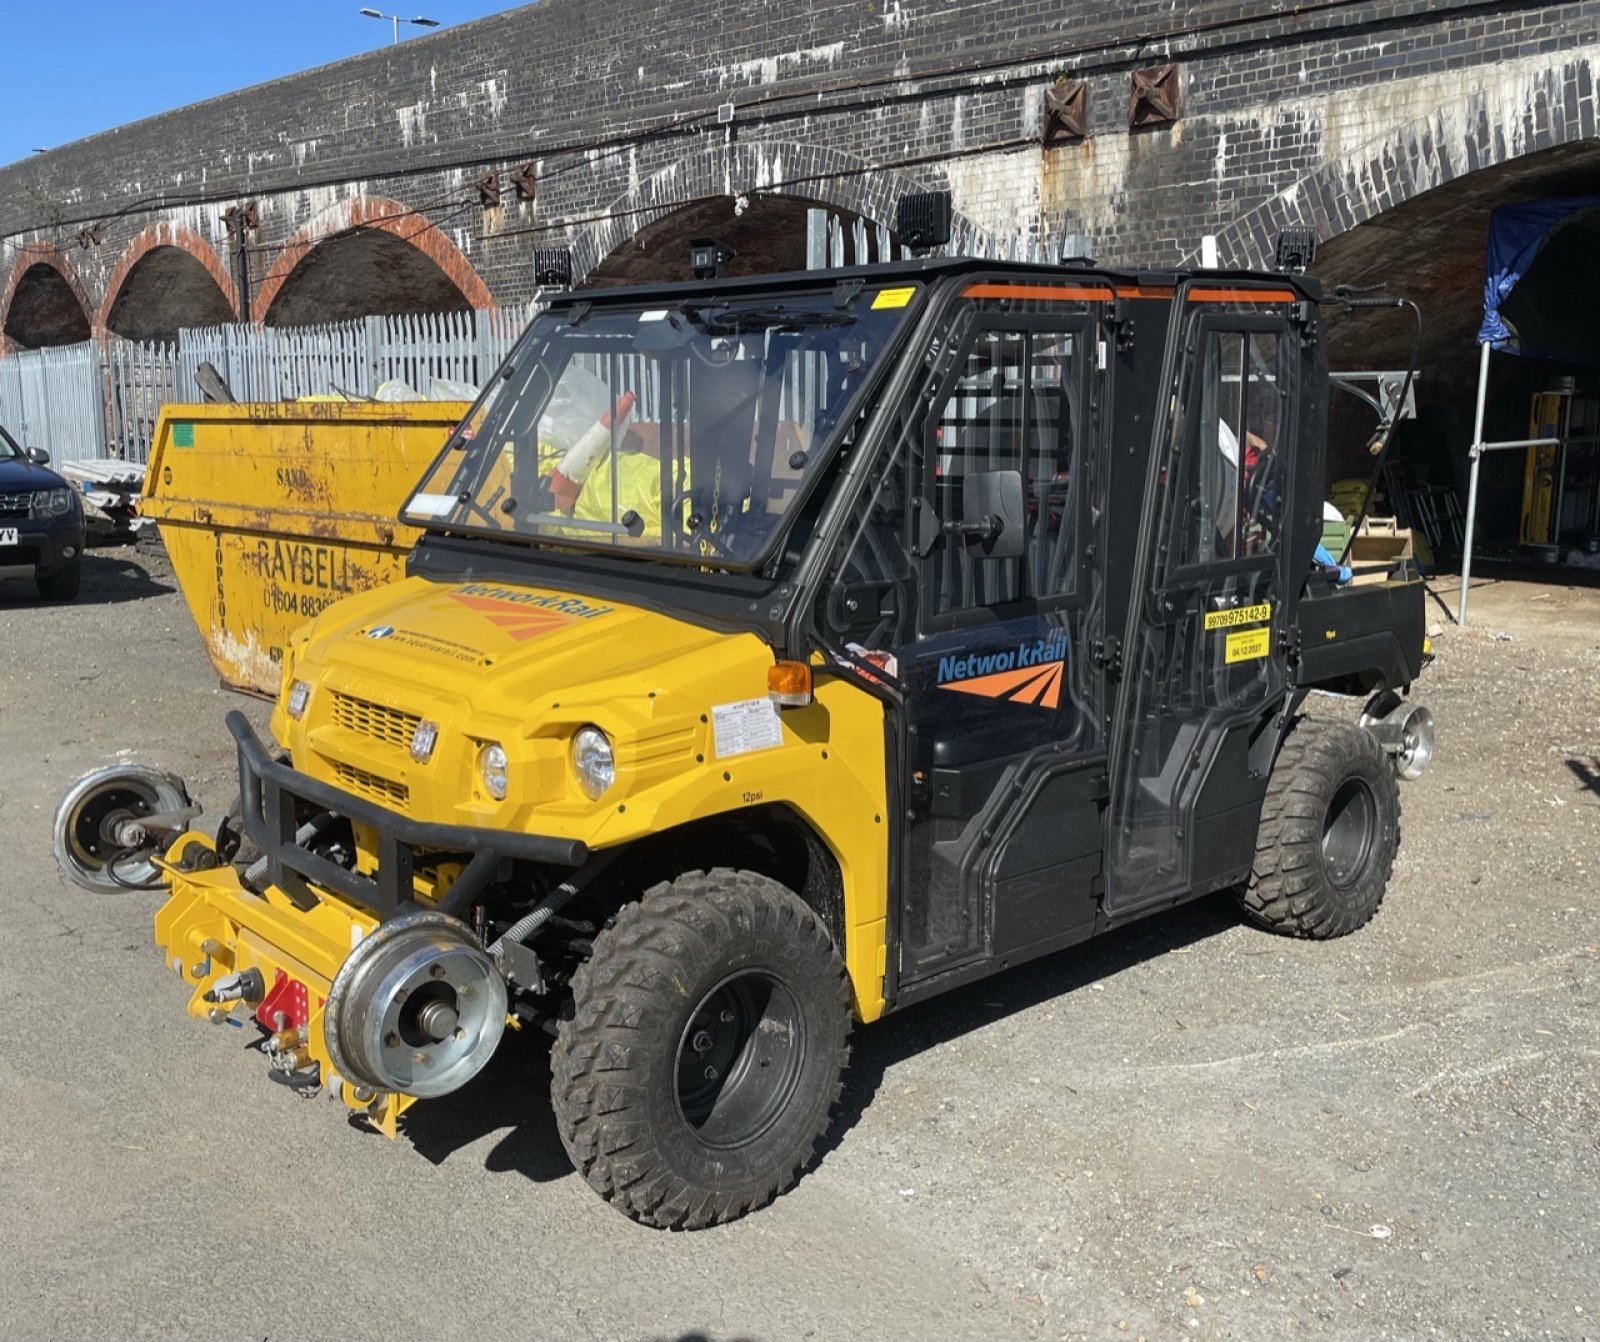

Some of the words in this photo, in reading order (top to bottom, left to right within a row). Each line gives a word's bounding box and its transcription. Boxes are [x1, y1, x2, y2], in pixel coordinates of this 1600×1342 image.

[249, 402, 281, 420] LEVEL
[311, 402, 343, 420] ONLY
[937, 635, 1068, 683] NetworkRail
[742, 790, 763, 803] 12psi
